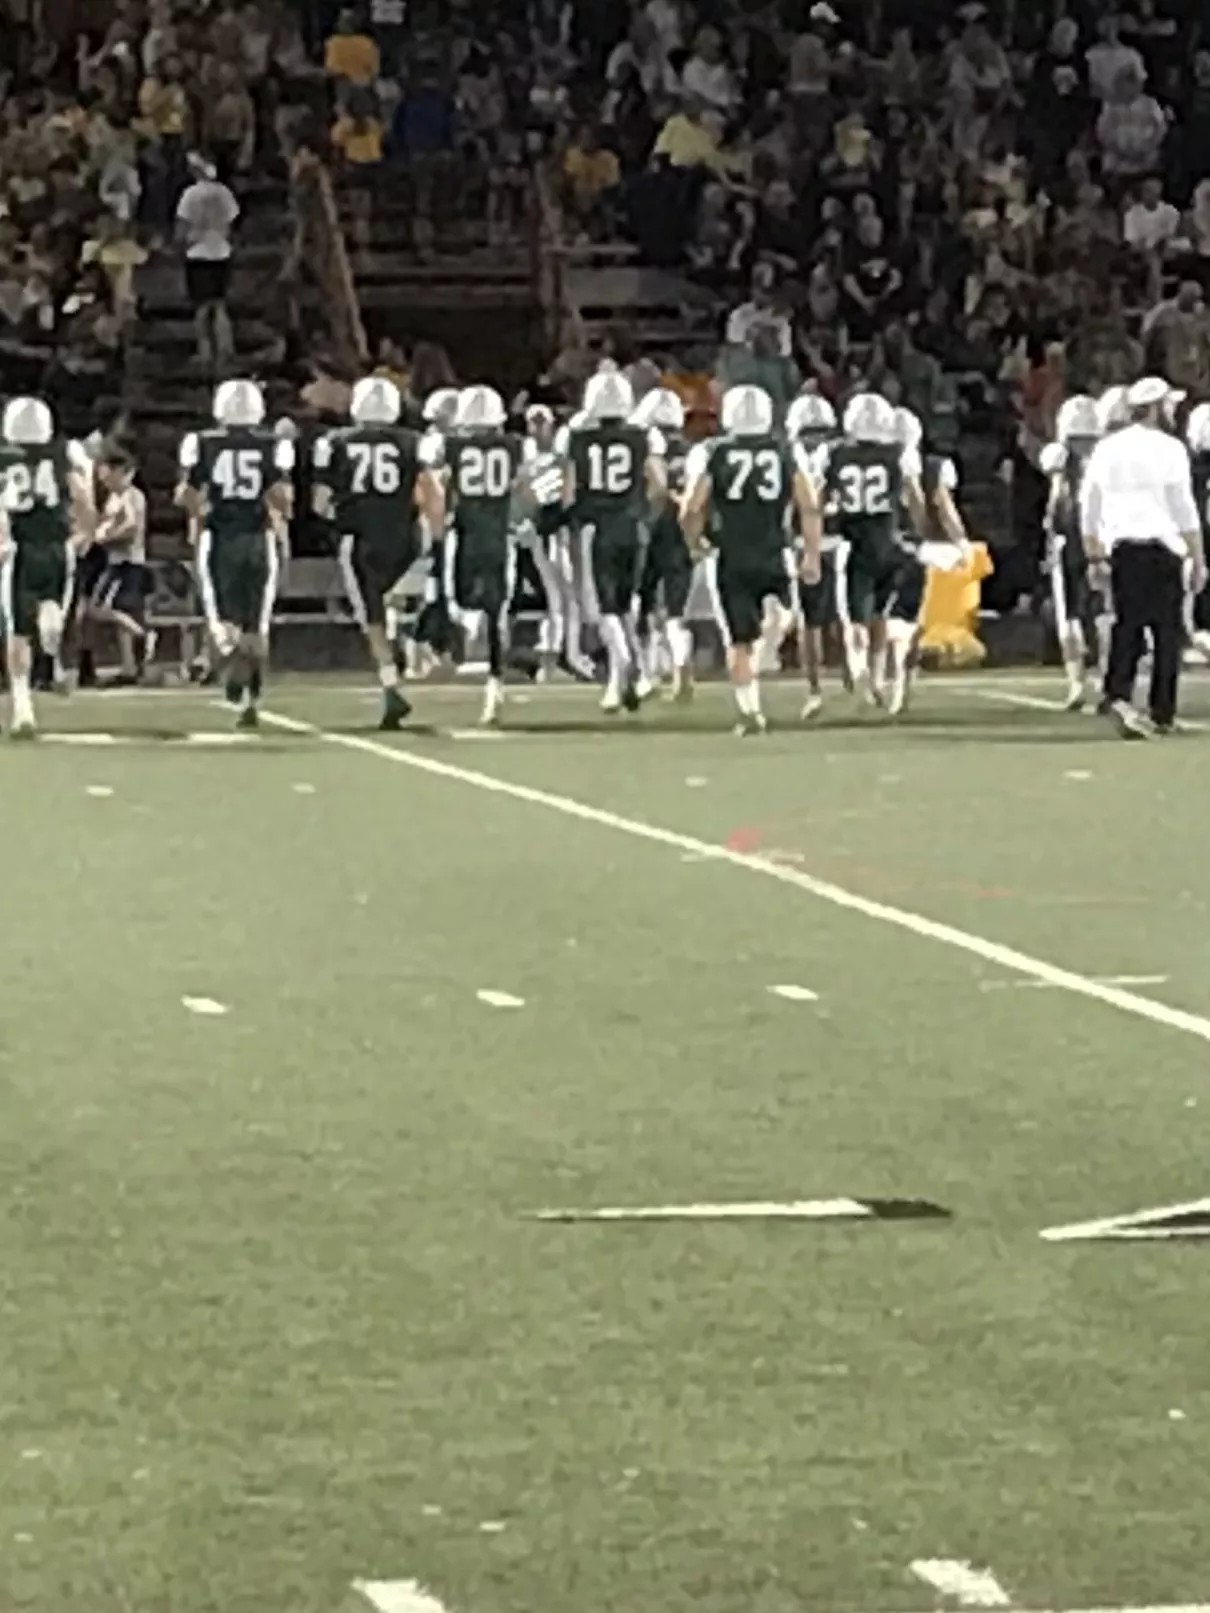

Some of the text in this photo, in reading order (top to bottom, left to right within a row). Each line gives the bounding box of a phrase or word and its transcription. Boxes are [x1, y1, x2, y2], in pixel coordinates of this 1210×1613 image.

[5, 458, 59, 512] 24
[212, 449, 262, 499] 45
[346, 443, 400, 493] 76
[460, 446, 510, 496] 20
[588, 444, 632, 493] 12
[726, 448, 781, 500] 73
[838, 464, 890, 513] 32
